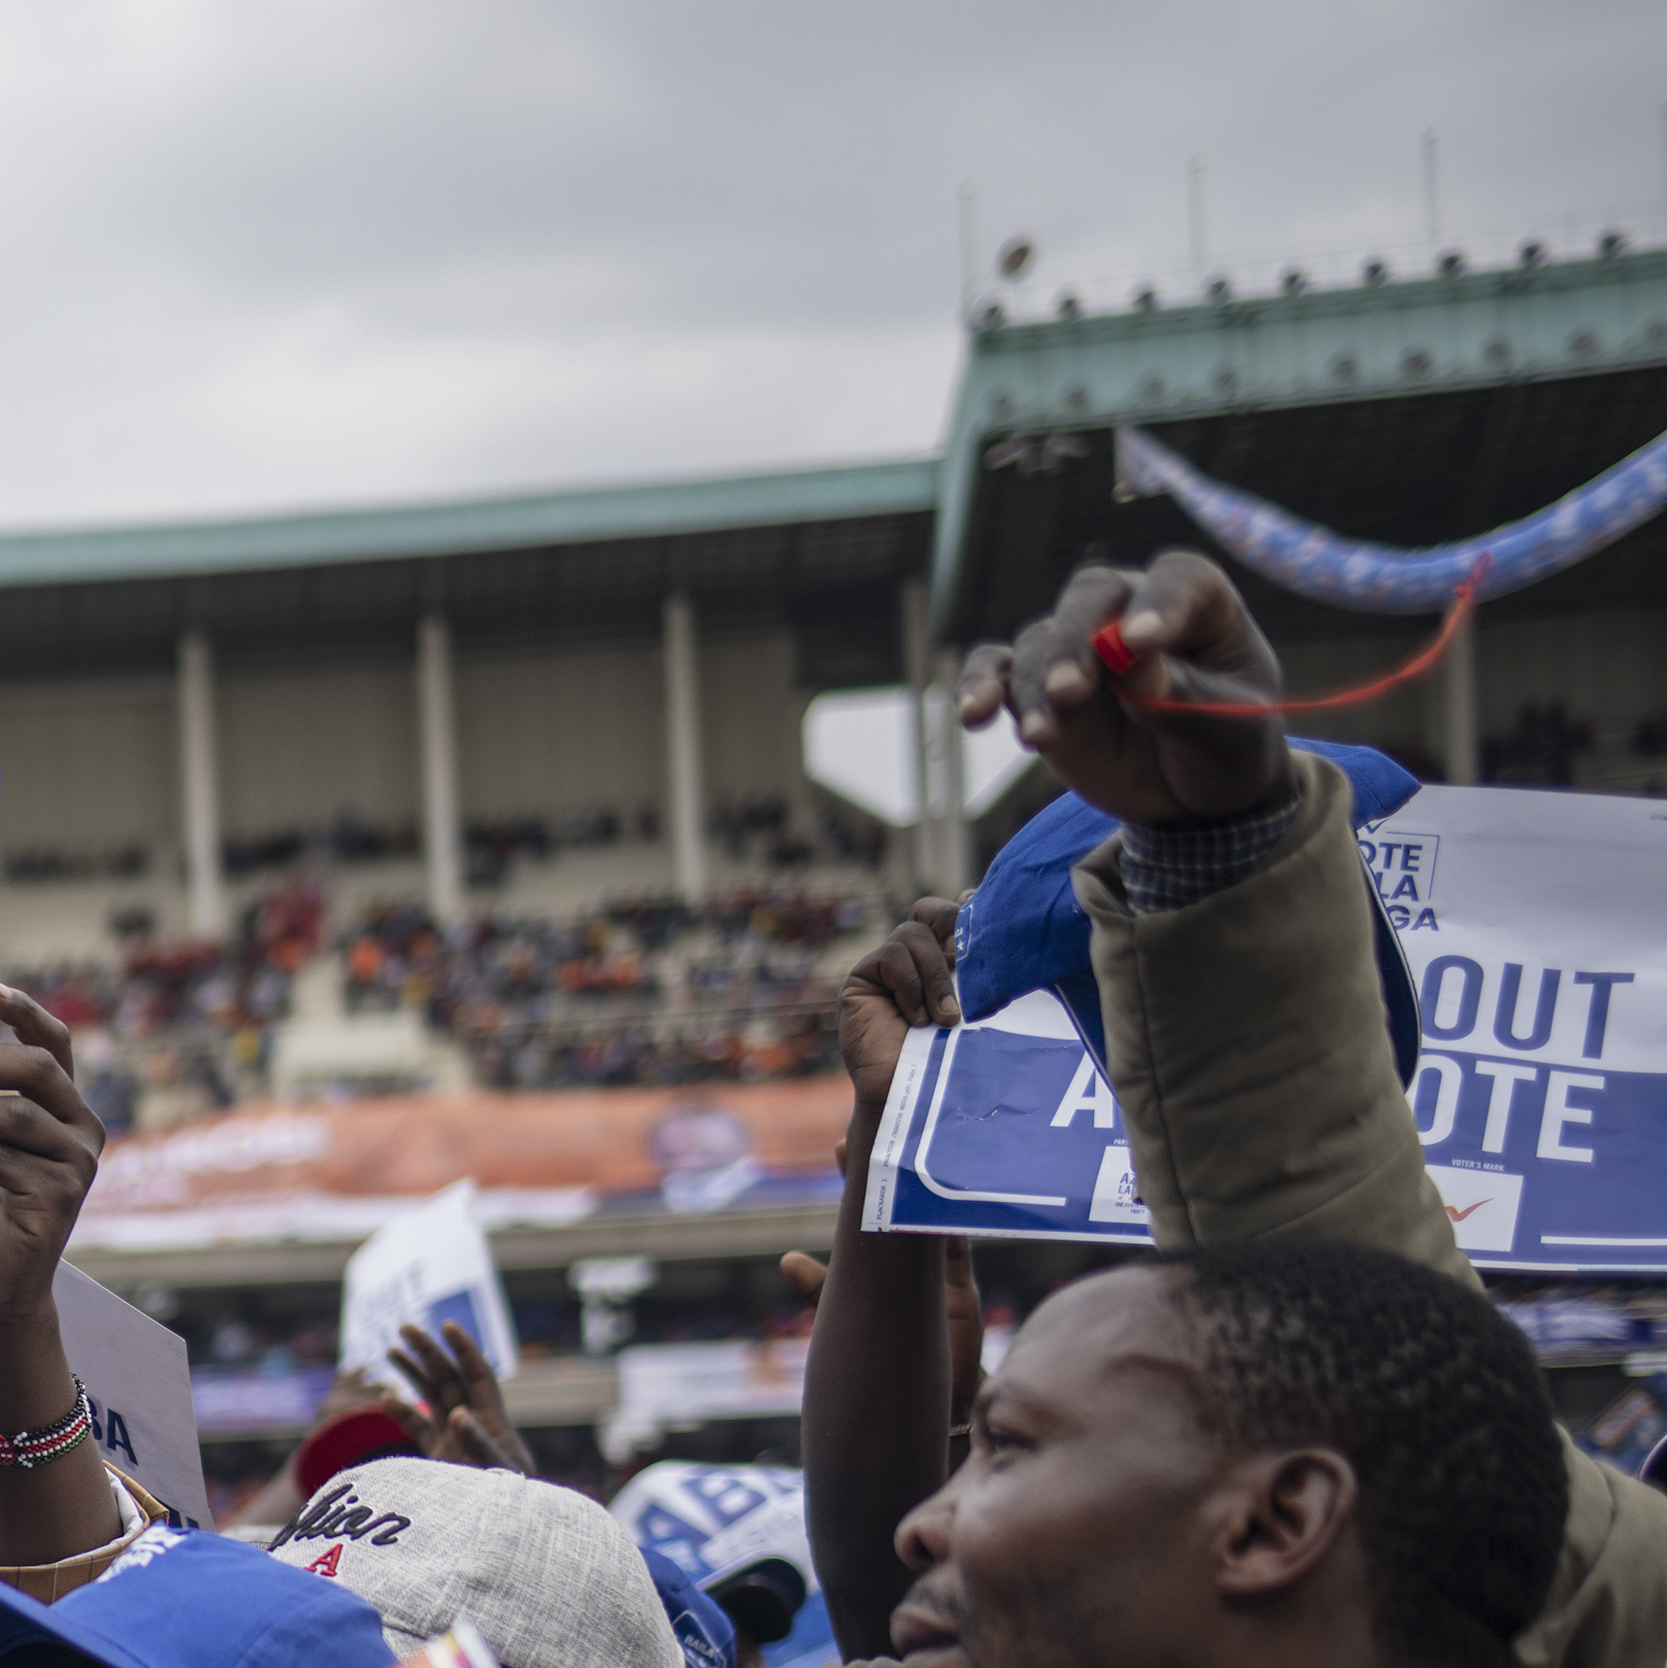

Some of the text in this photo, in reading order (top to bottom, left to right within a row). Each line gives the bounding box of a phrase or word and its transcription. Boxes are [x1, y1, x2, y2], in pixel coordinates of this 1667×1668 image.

[1359, 840, 1423, 873] OTE
[1419, 954, 1636, 1060] OUT
[1411, 1053, 1606, 1164] OTE
[1483, 1161, 1506, 1175] MARK
